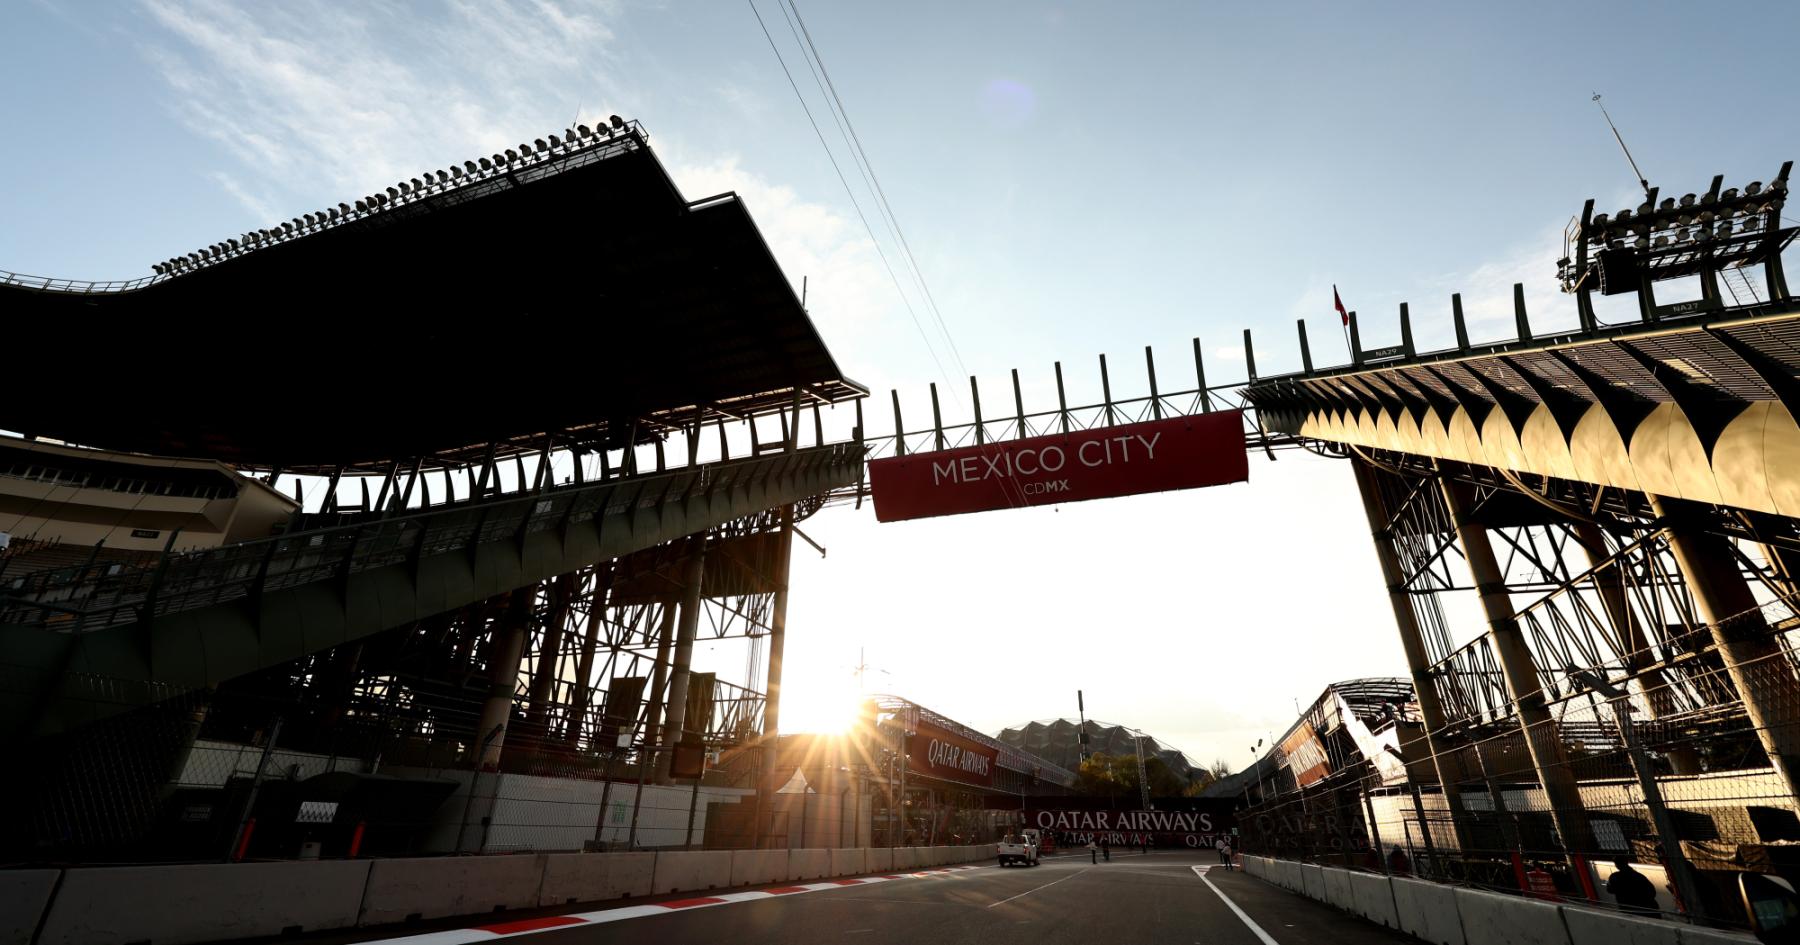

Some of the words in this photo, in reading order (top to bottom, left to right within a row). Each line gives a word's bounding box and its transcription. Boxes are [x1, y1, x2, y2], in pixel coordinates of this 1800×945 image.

[933, 445, 1065, 486] MEXICO
[1078, 432, 1162, 467] CITY
[1023, 479, 1070, 496] CDMX
[928, 738, 960, 768] QATAR
[958, 749, 990, 776] AIRWAYS
[1037, 811, 1110, 829] QATAR
[1116, 811, 1213, 832] AIRWAYS
